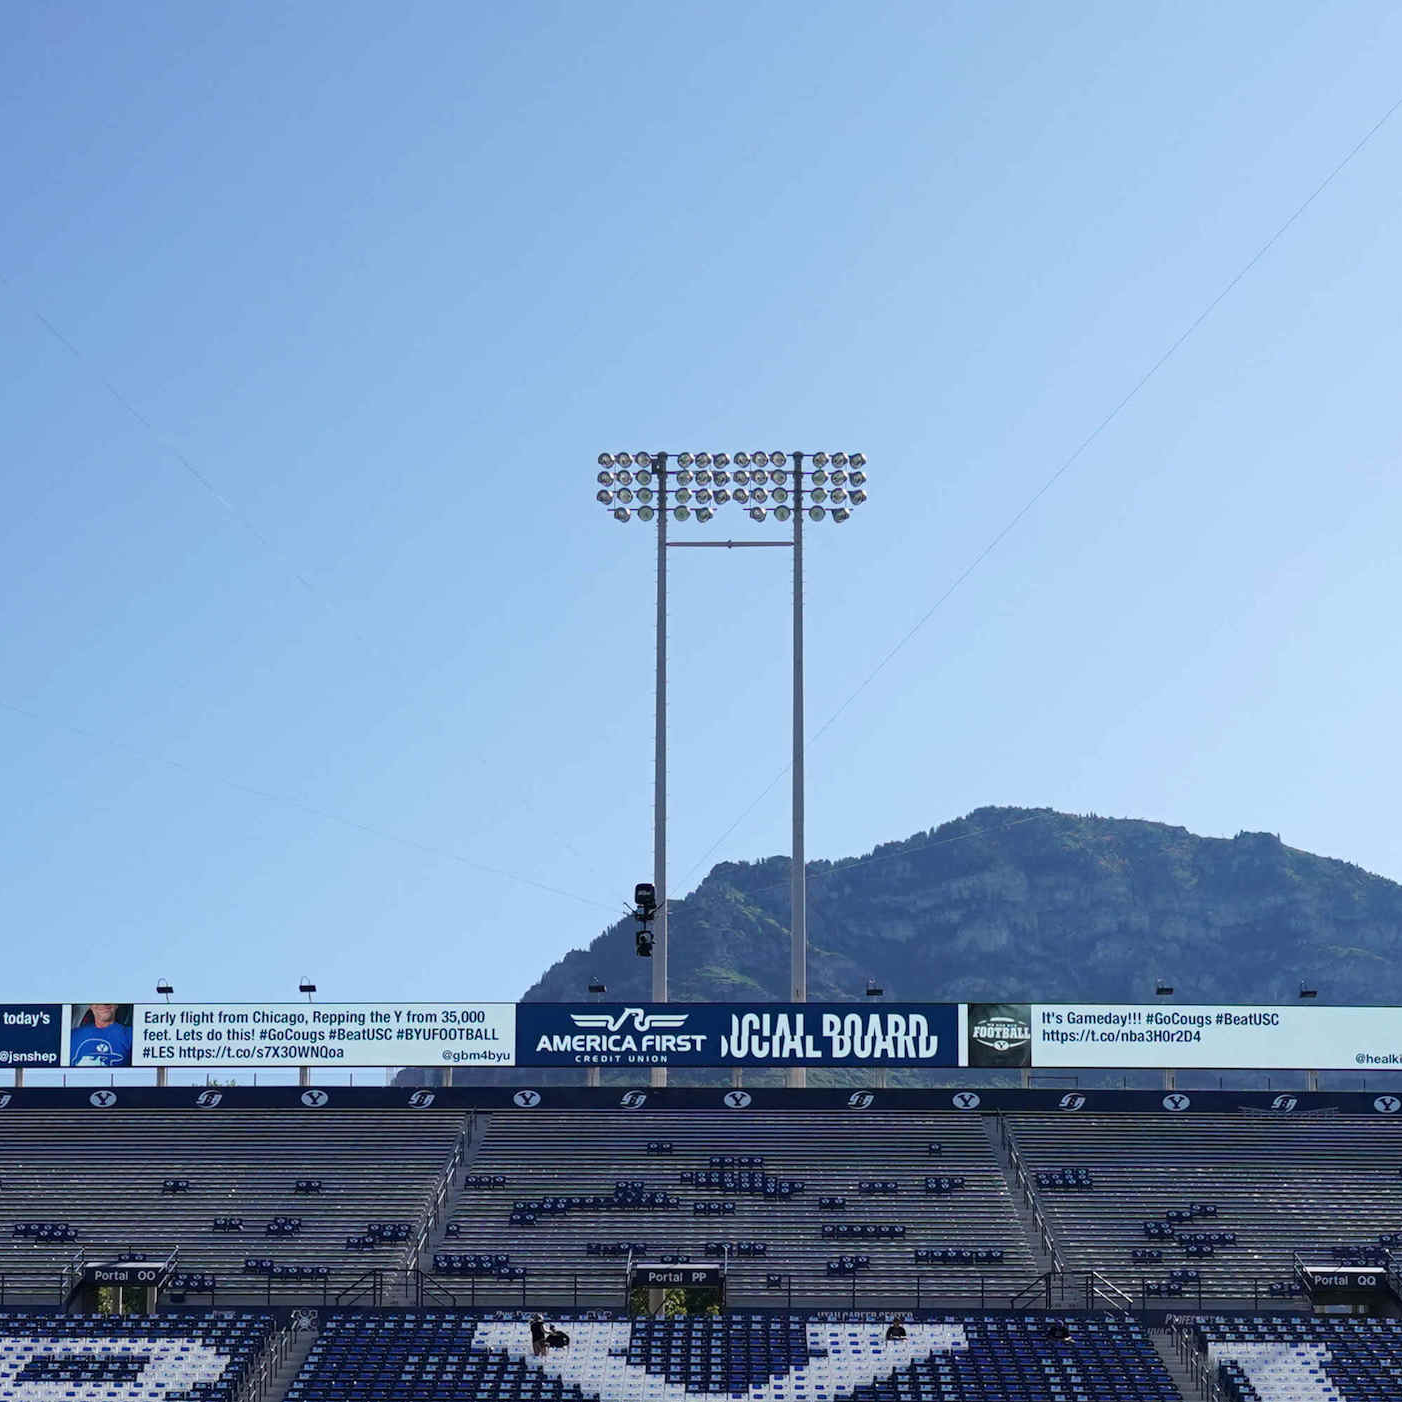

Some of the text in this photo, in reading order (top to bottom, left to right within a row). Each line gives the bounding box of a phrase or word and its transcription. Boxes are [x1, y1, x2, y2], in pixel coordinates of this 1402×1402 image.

[3, 1011, 50, 1027] today's
[144, 1011, 486, 1026] Early flight from Chicago, Repping the Y from 35,000
[1041, 1011, 1280, 1026] It's Gameday!!! #GoCougs #BeatUSC
[143, 1028, 499, 1043] feet. Lets do this! #GoCougs #BeatUSC #BYUFOOTBALL
[822, 1013, 938, 1059] BOARD
[972, 1026, 1031, 1039] FOOTBALL
[536, 1034, 707, 1053] AMERICA FIRST
[143, 1046, 176, 1059] #LES
[442, 1049, 510, 1063] @gbm4byu
[574, 1054, 668, 1063] CREDIT UNION
[94, 1270, 156, 1281] Portal OO
[648, 1272, 707, 1282] Portal PP
[1314, 1275, 1377, 1286] Portal QQ
